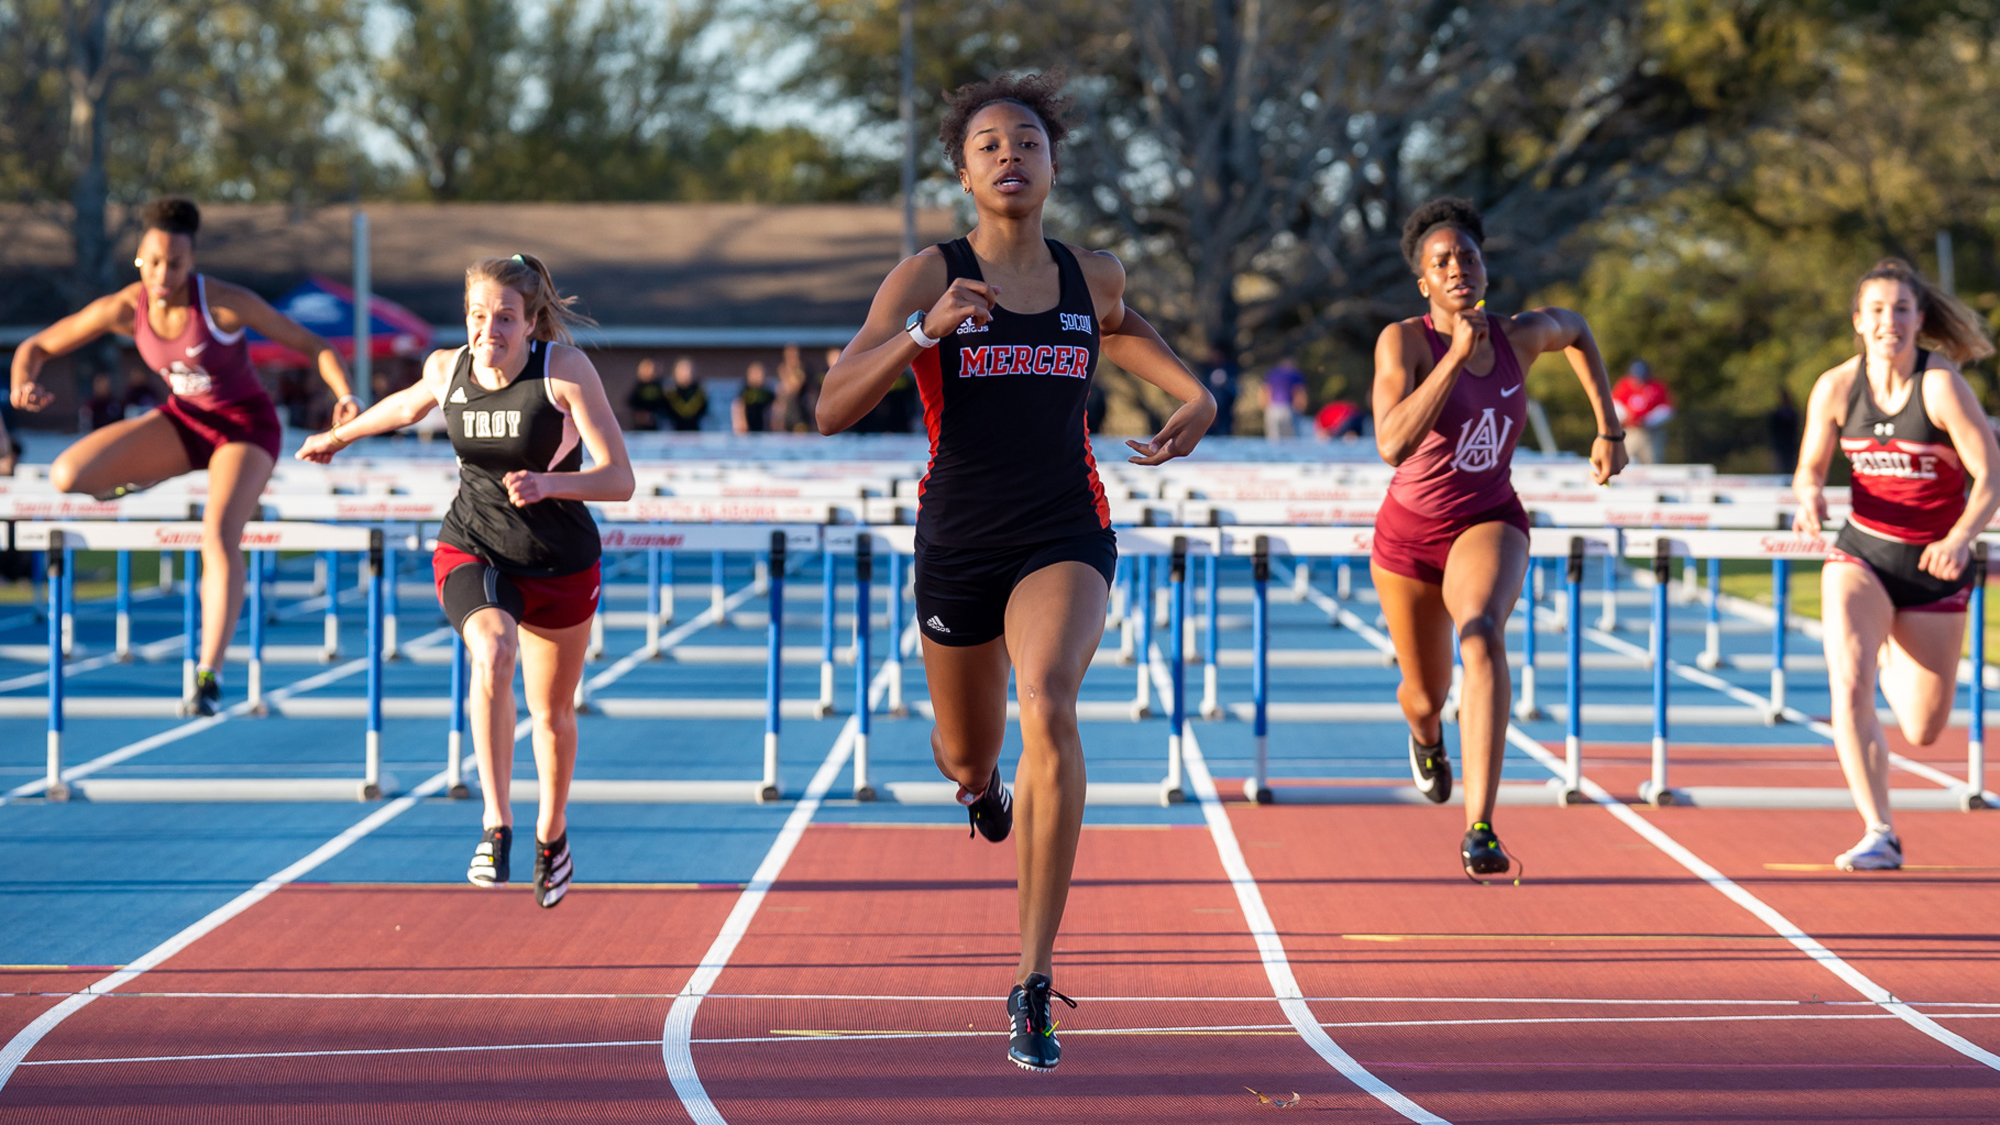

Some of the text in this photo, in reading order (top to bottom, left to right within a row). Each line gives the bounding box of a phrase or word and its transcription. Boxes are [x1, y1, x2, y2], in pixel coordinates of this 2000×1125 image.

[1059, 312, 1092, 335] SOCON
[959, 345, 1090, 380] MERCER
[462, 410, 521, 438] TROY
